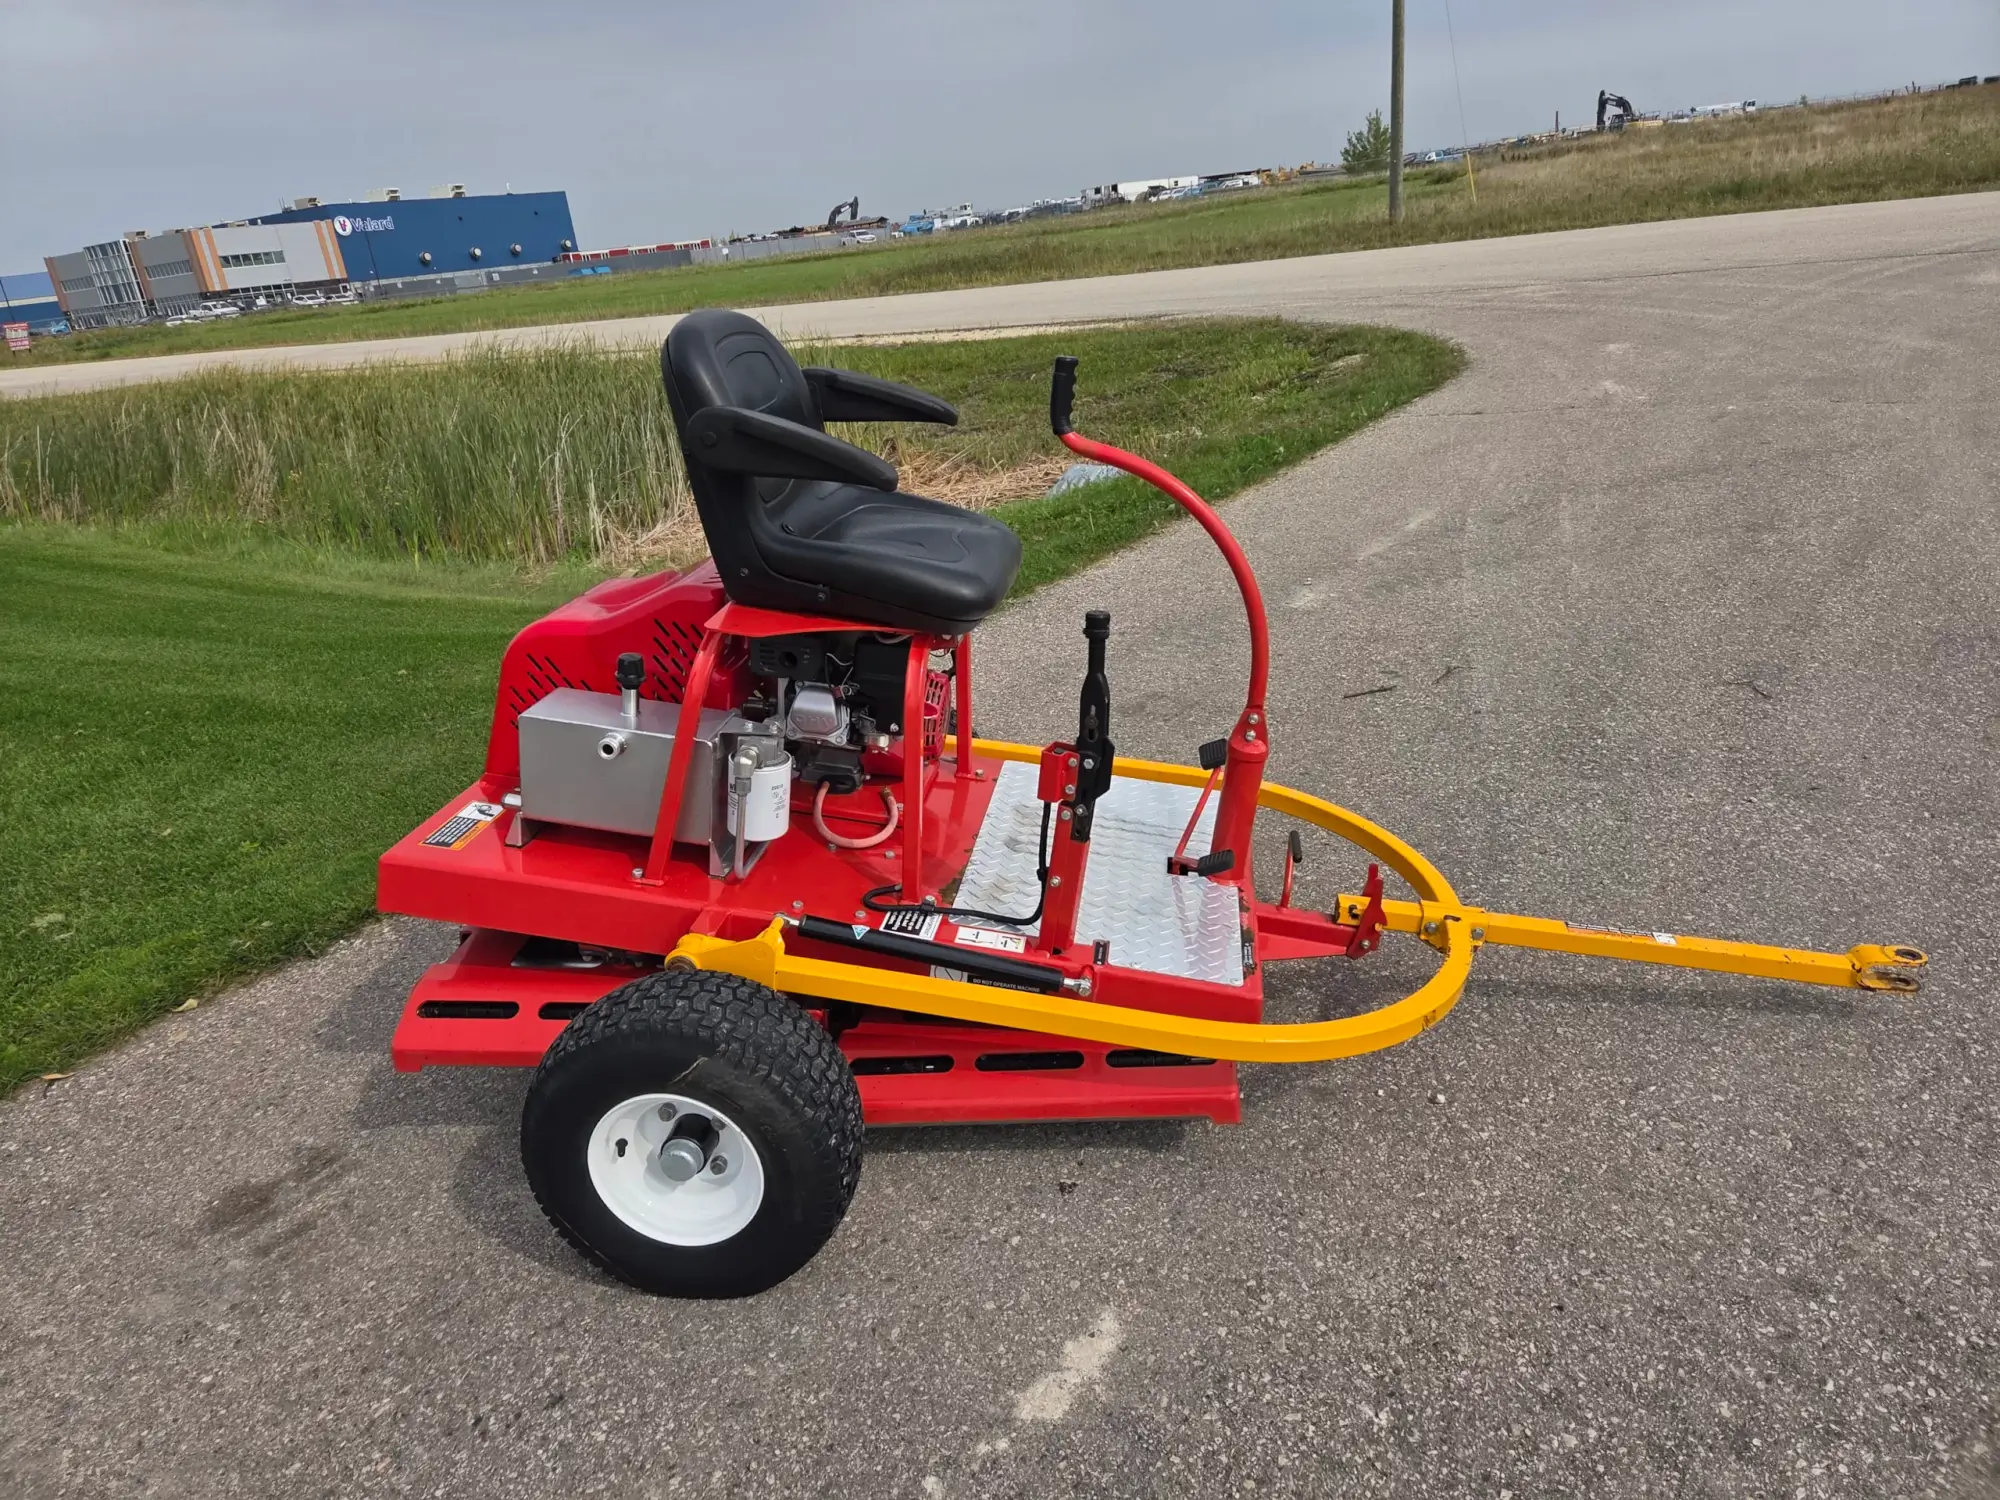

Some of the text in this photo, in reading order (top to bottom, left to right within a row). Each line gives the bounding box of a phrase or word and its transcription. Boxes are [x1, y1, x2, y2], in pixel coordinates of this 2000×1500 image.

[350, 216, 394, 232] Valard
[993, 981, 1016, 989] OPERATE
[1017, 984, 1040, 993] MACHINE
